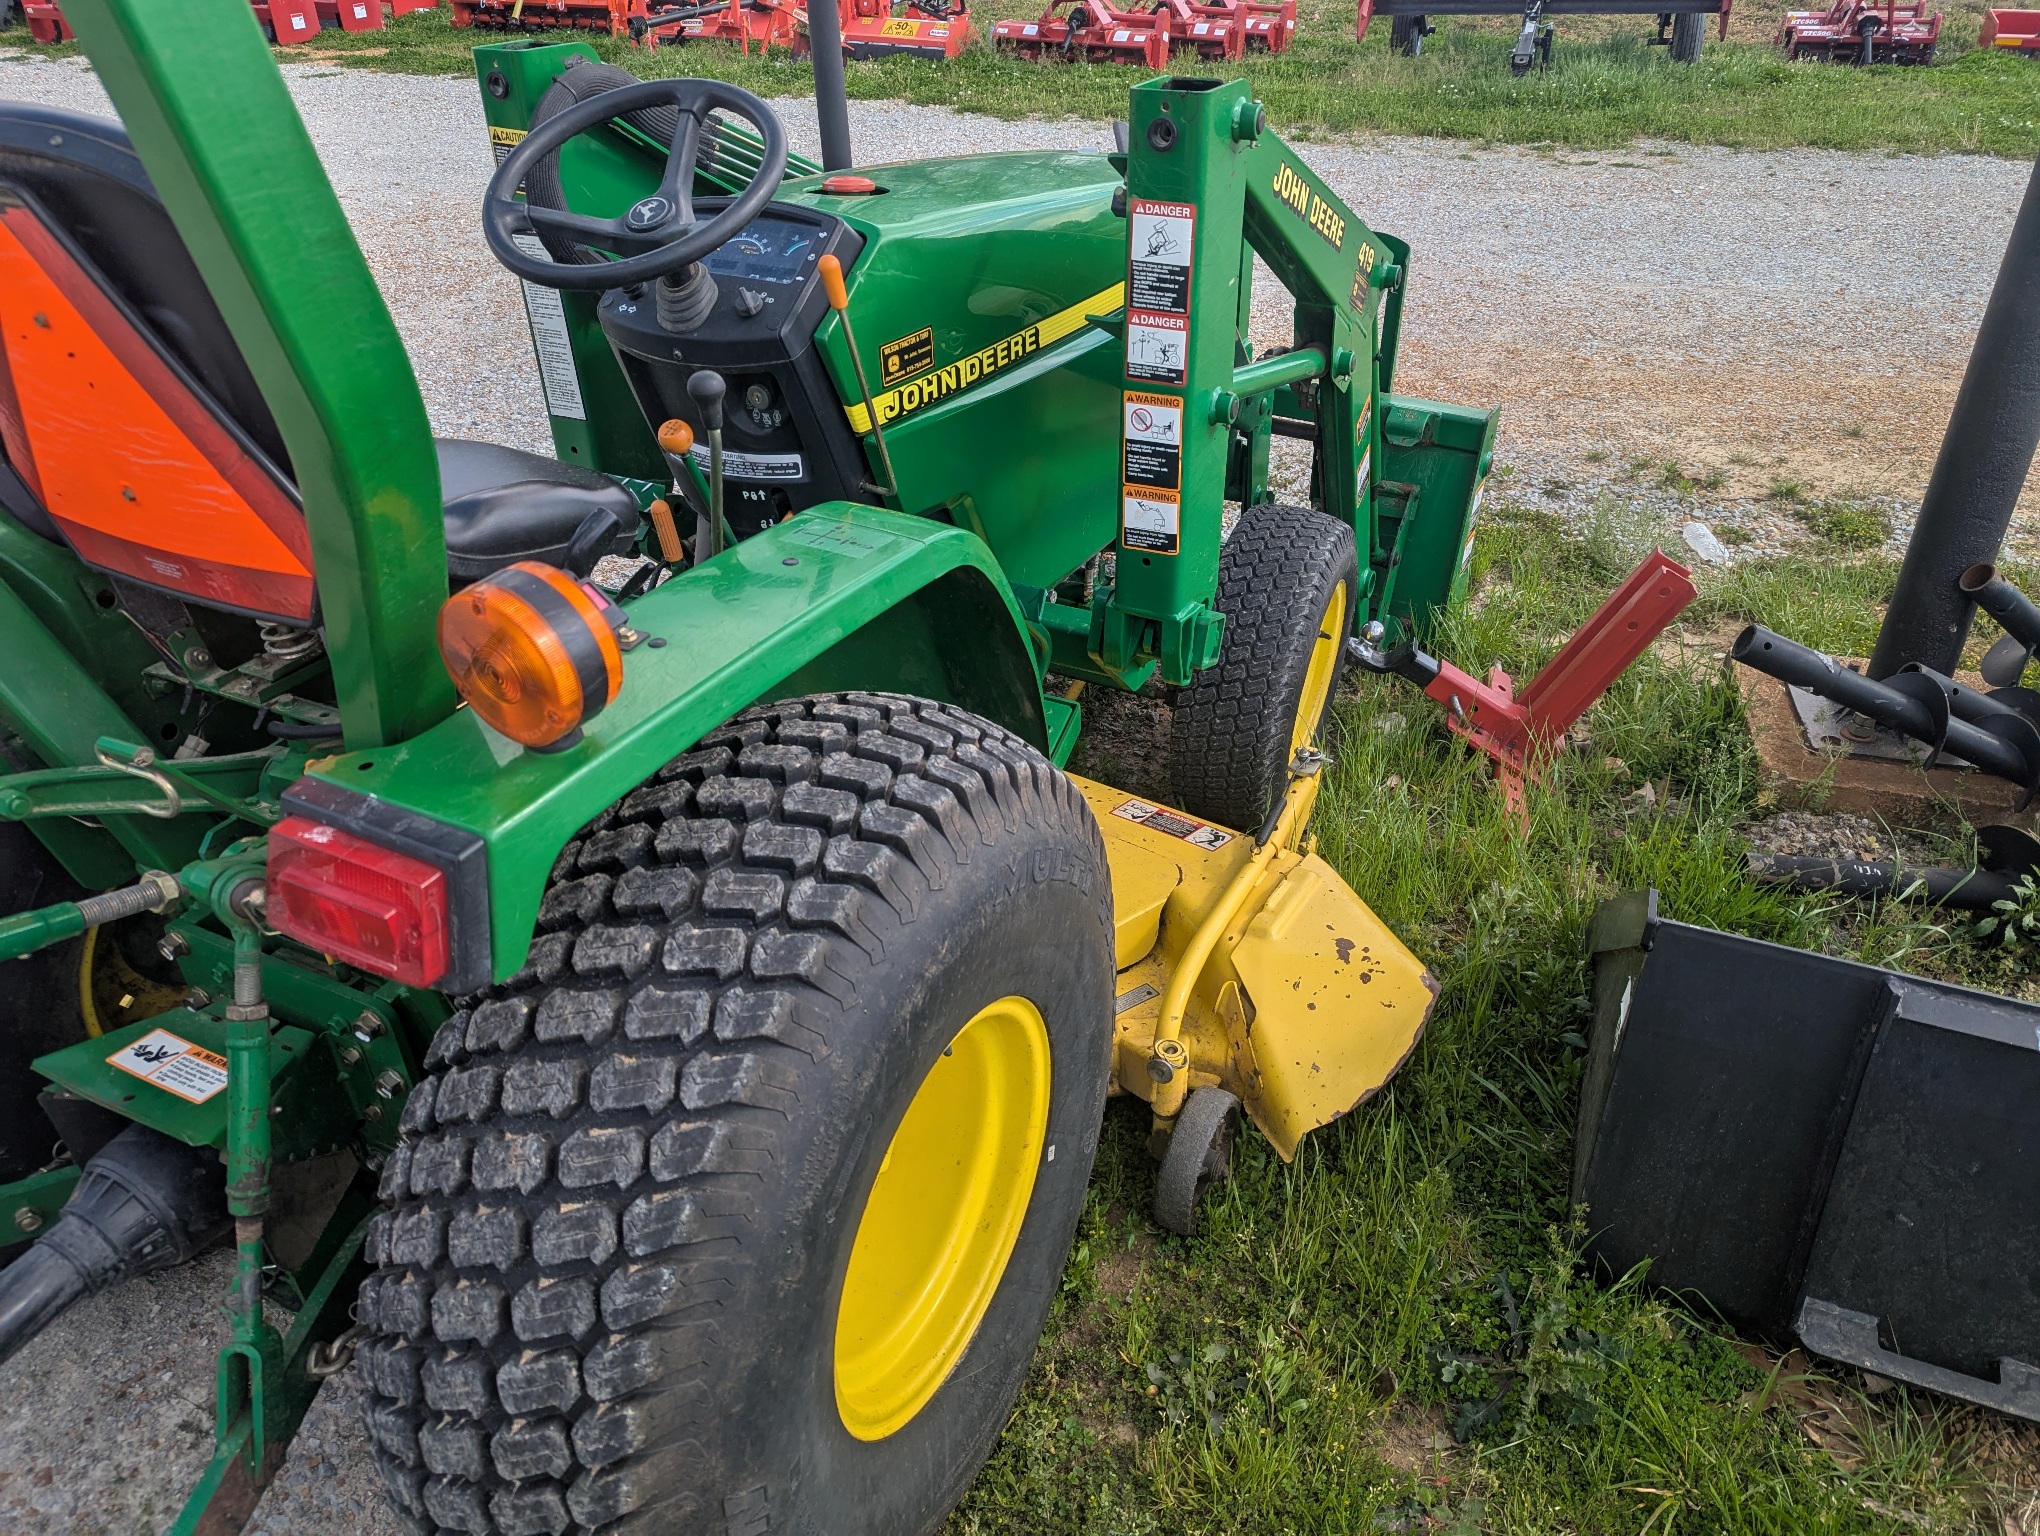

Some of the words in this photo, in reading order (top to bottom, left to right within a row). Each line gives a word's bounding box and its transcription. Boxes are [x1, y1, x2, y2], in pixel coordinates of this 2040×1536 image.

[895, 22, 908, 30] 50
[1146, 204, 1190, 217] DANGER
[1273, 161, 1310, 217] JOHN
[1309, 193, 1345, 250] DEERE
[1358, 241, 1375, 273] 419
[1141, 315, 1184, 328] DANGER
[884, 366, 957, 419] JOHN
[965, 327, 1038, 384] DEERE
[1135, 395, 1180, 407] WARNING
[1134, 489, 1176, 502] WARNING
